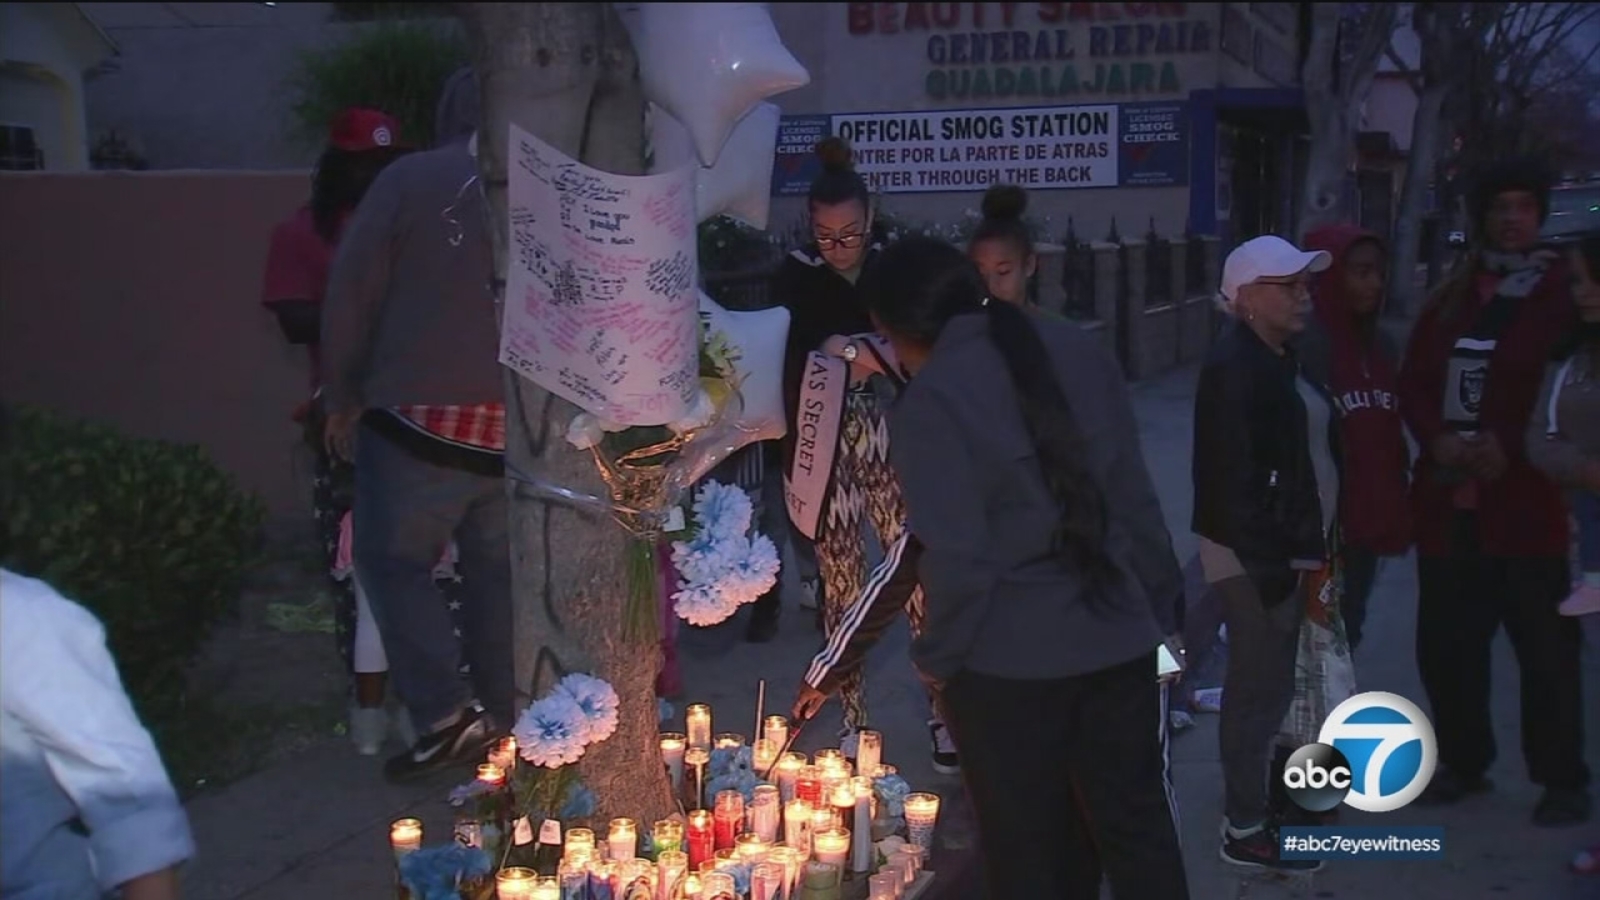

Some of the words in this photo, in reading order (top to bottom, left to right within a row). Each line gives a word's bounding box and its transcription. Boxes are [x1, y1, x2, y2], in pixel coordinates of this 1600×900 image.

[848, 2, 1014, 36] BEAUTY
[926, 29, 1075, 65] GENERAL
[1089, 21, 1211, 57] REPAIR
[925, 61, 1180, 98] GUADALAJARA
[839, 118, 934, 143] OFFICIAL
[941, 117, 1004, 141] SMOG
[1011, 112, 1108, 138] STATION
[1123, 132, 1181, 143] CHECK
[1129, 122, 1175, 132] SMOG
[776, 144, 815, 154] CHEC
[853, 148, 896, 164] NTRE
[901, 148, 935, 163] POR
[940, 147, 961, 162] LA
[966, 145, 1019, 161] PARTE
[1024, 144, 1047, 160] DE
[1052, 142, 1108, 160] ATRAS
[917, 168, 1000, 186] THROUGH
[1005, 168, 1039, 184] THE
[1044, 166, 1092, 183] BACK
[799, 398, 825, 477] SECRET
